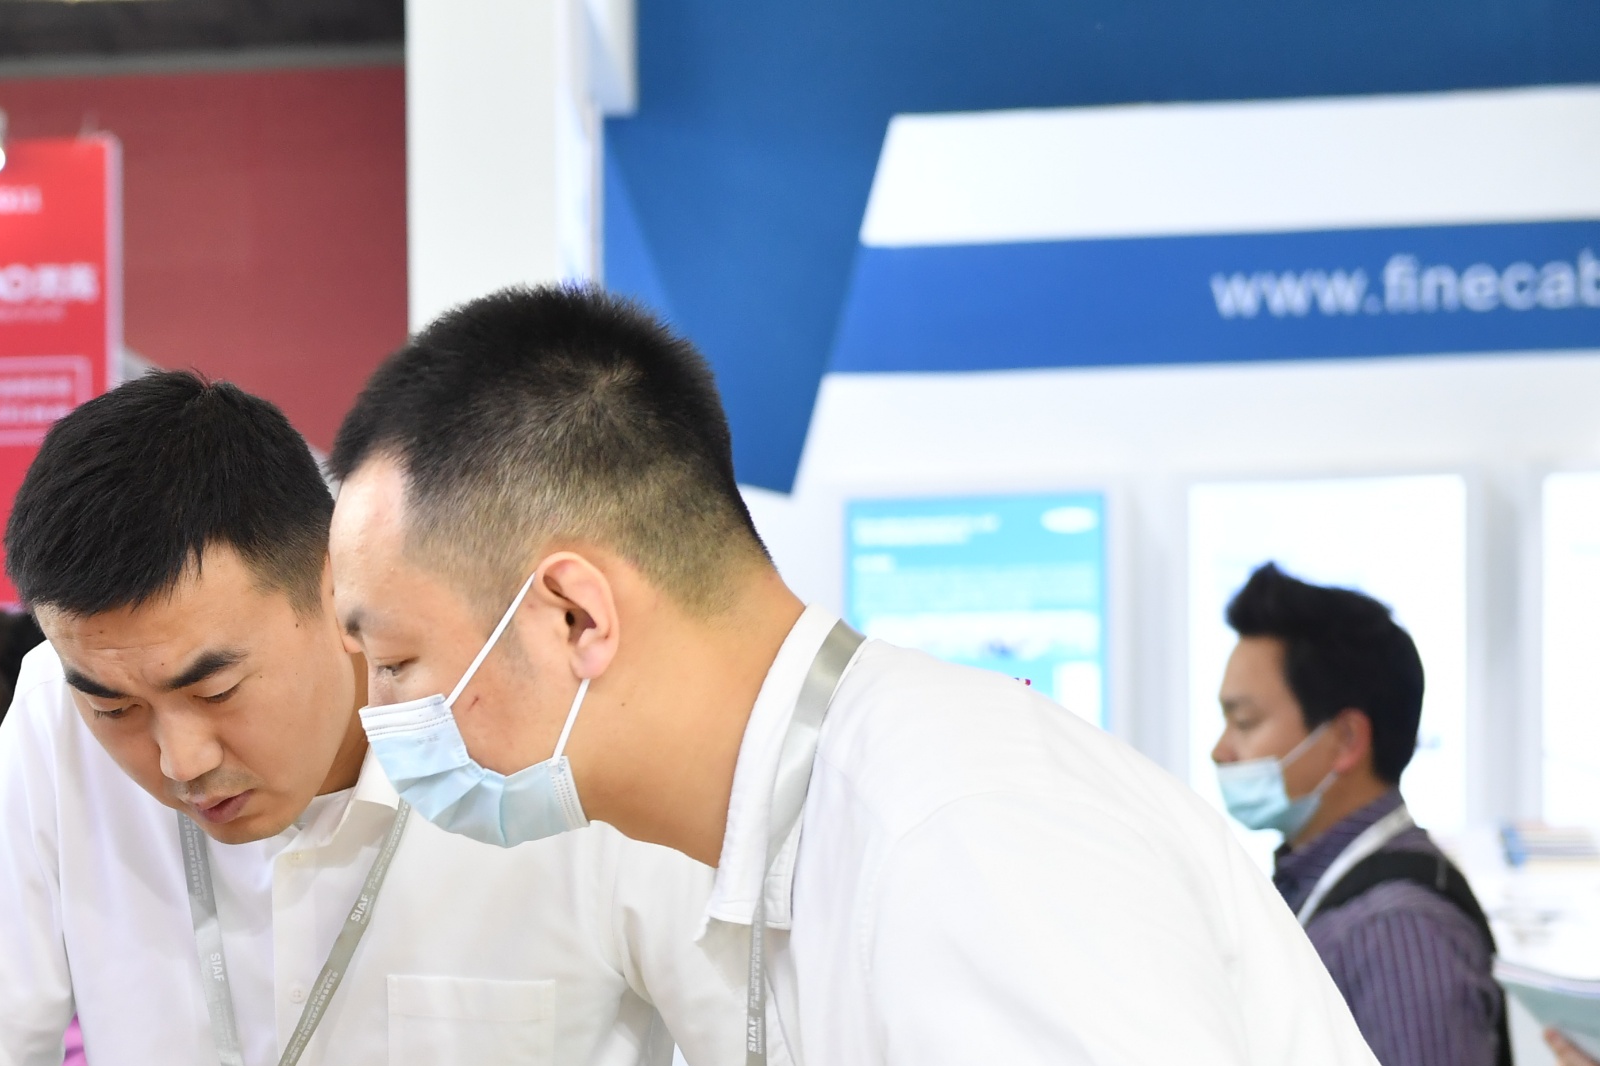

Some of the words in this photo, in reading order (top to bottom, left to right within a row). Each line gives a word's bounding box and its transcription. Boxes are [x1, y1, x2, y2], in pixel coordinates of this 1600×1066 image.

[349, 892, 371, 923] SIAF
[209, 951, 224, 983] SIAF
[746, 1015, 758, 1052] SIAF
